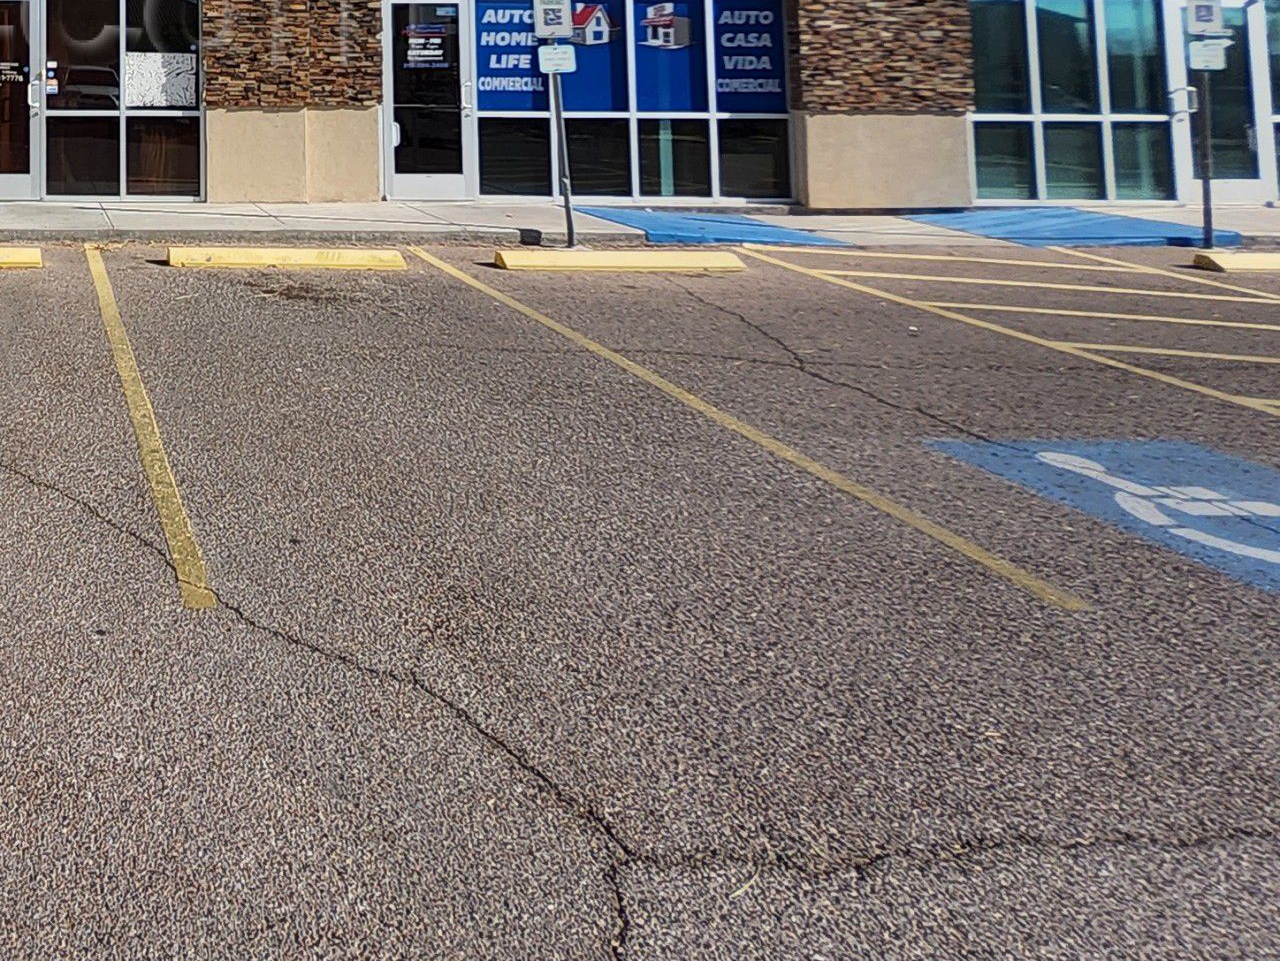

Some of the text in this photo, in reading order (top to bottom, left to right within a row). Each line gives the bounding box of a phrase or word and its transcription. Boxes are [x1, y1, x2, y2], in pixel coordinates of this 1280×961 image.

[481, 9, 535, 24] AUTO
[718, 10, 774, 25] AUTO
[480, 31, 539, 47] HOME
[720, 33, 773, 47] CASA
[489, 54, 532, 69] LIFE
[723, 56, 773, 70] VIDA
[478, 76, 545, 92] COMMERCIAL
